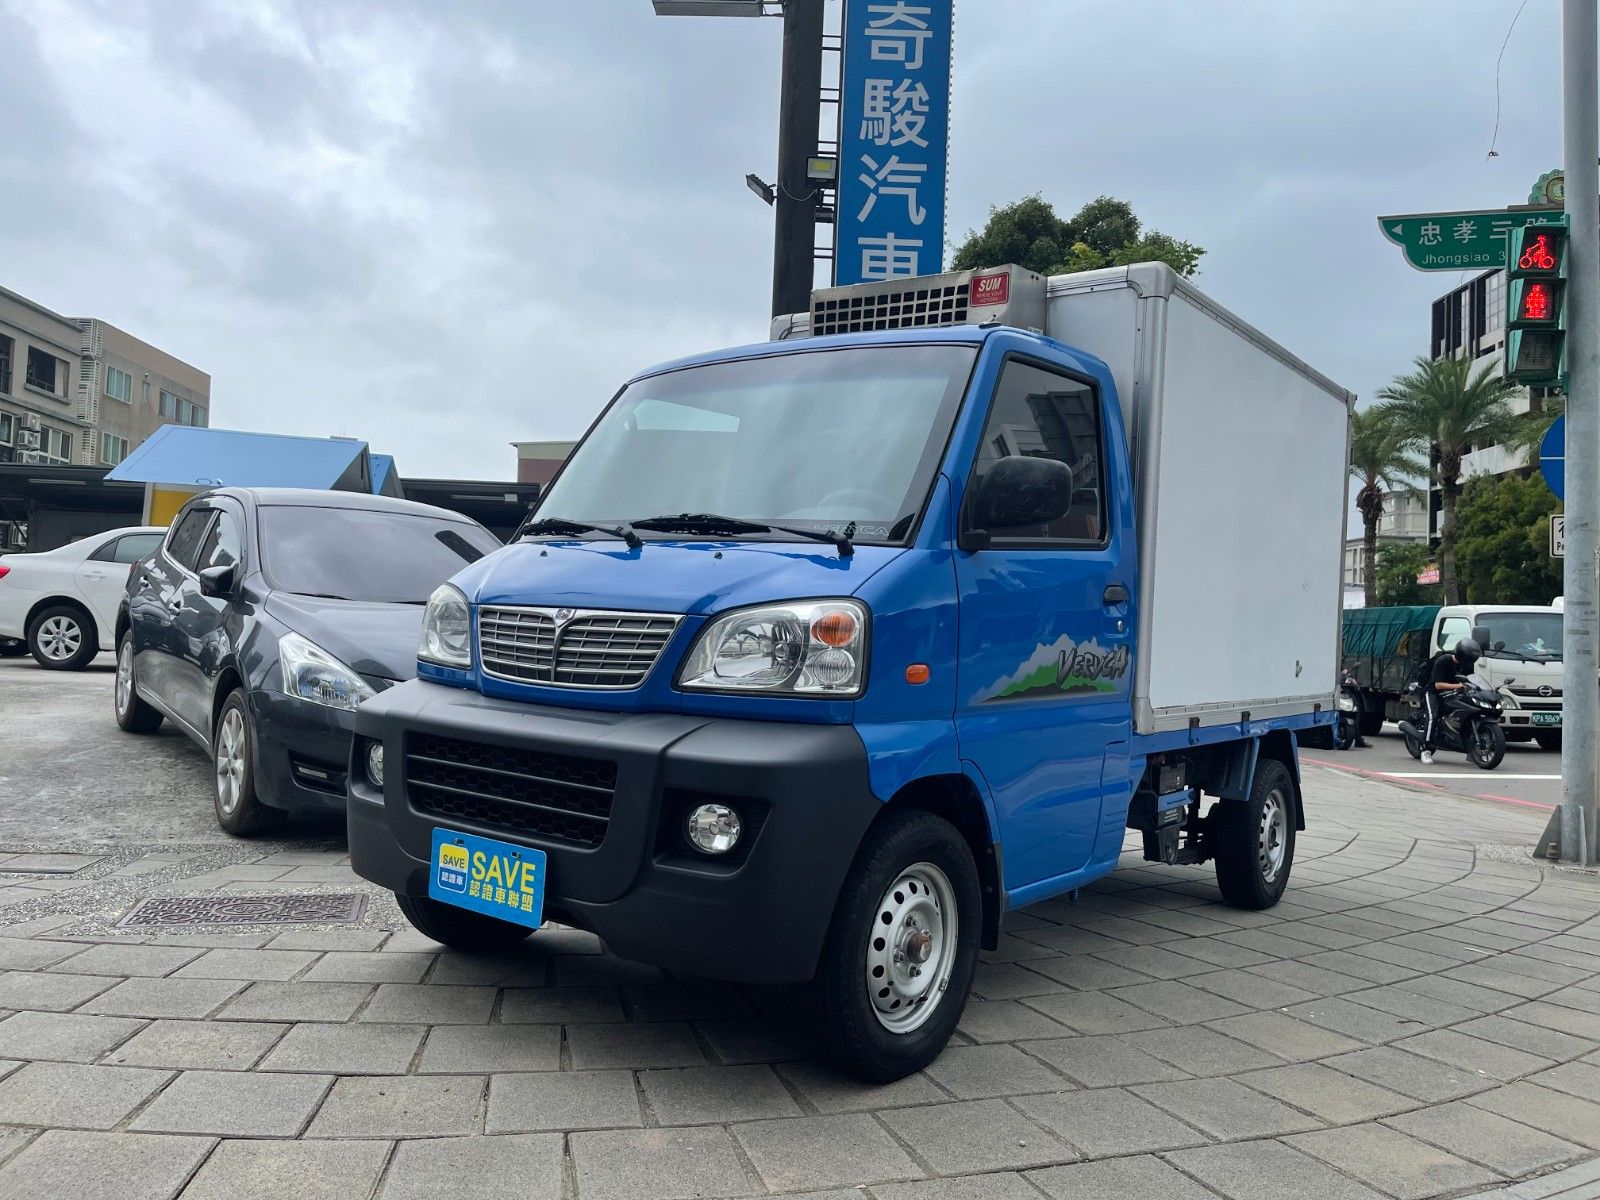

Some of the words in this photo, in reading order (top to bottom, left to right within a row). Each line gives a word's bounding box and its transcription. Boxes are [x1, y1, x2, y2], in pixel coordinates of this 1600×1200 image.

[858, 1, 933, 281] 奇駿汽車
[1422, 252, 1490, 265] Jhongsiao
[978, 277, 1002, 292] SUM
[442, 854, 465, 869] SAVE
[471, 851, 536, 894] SAVE
